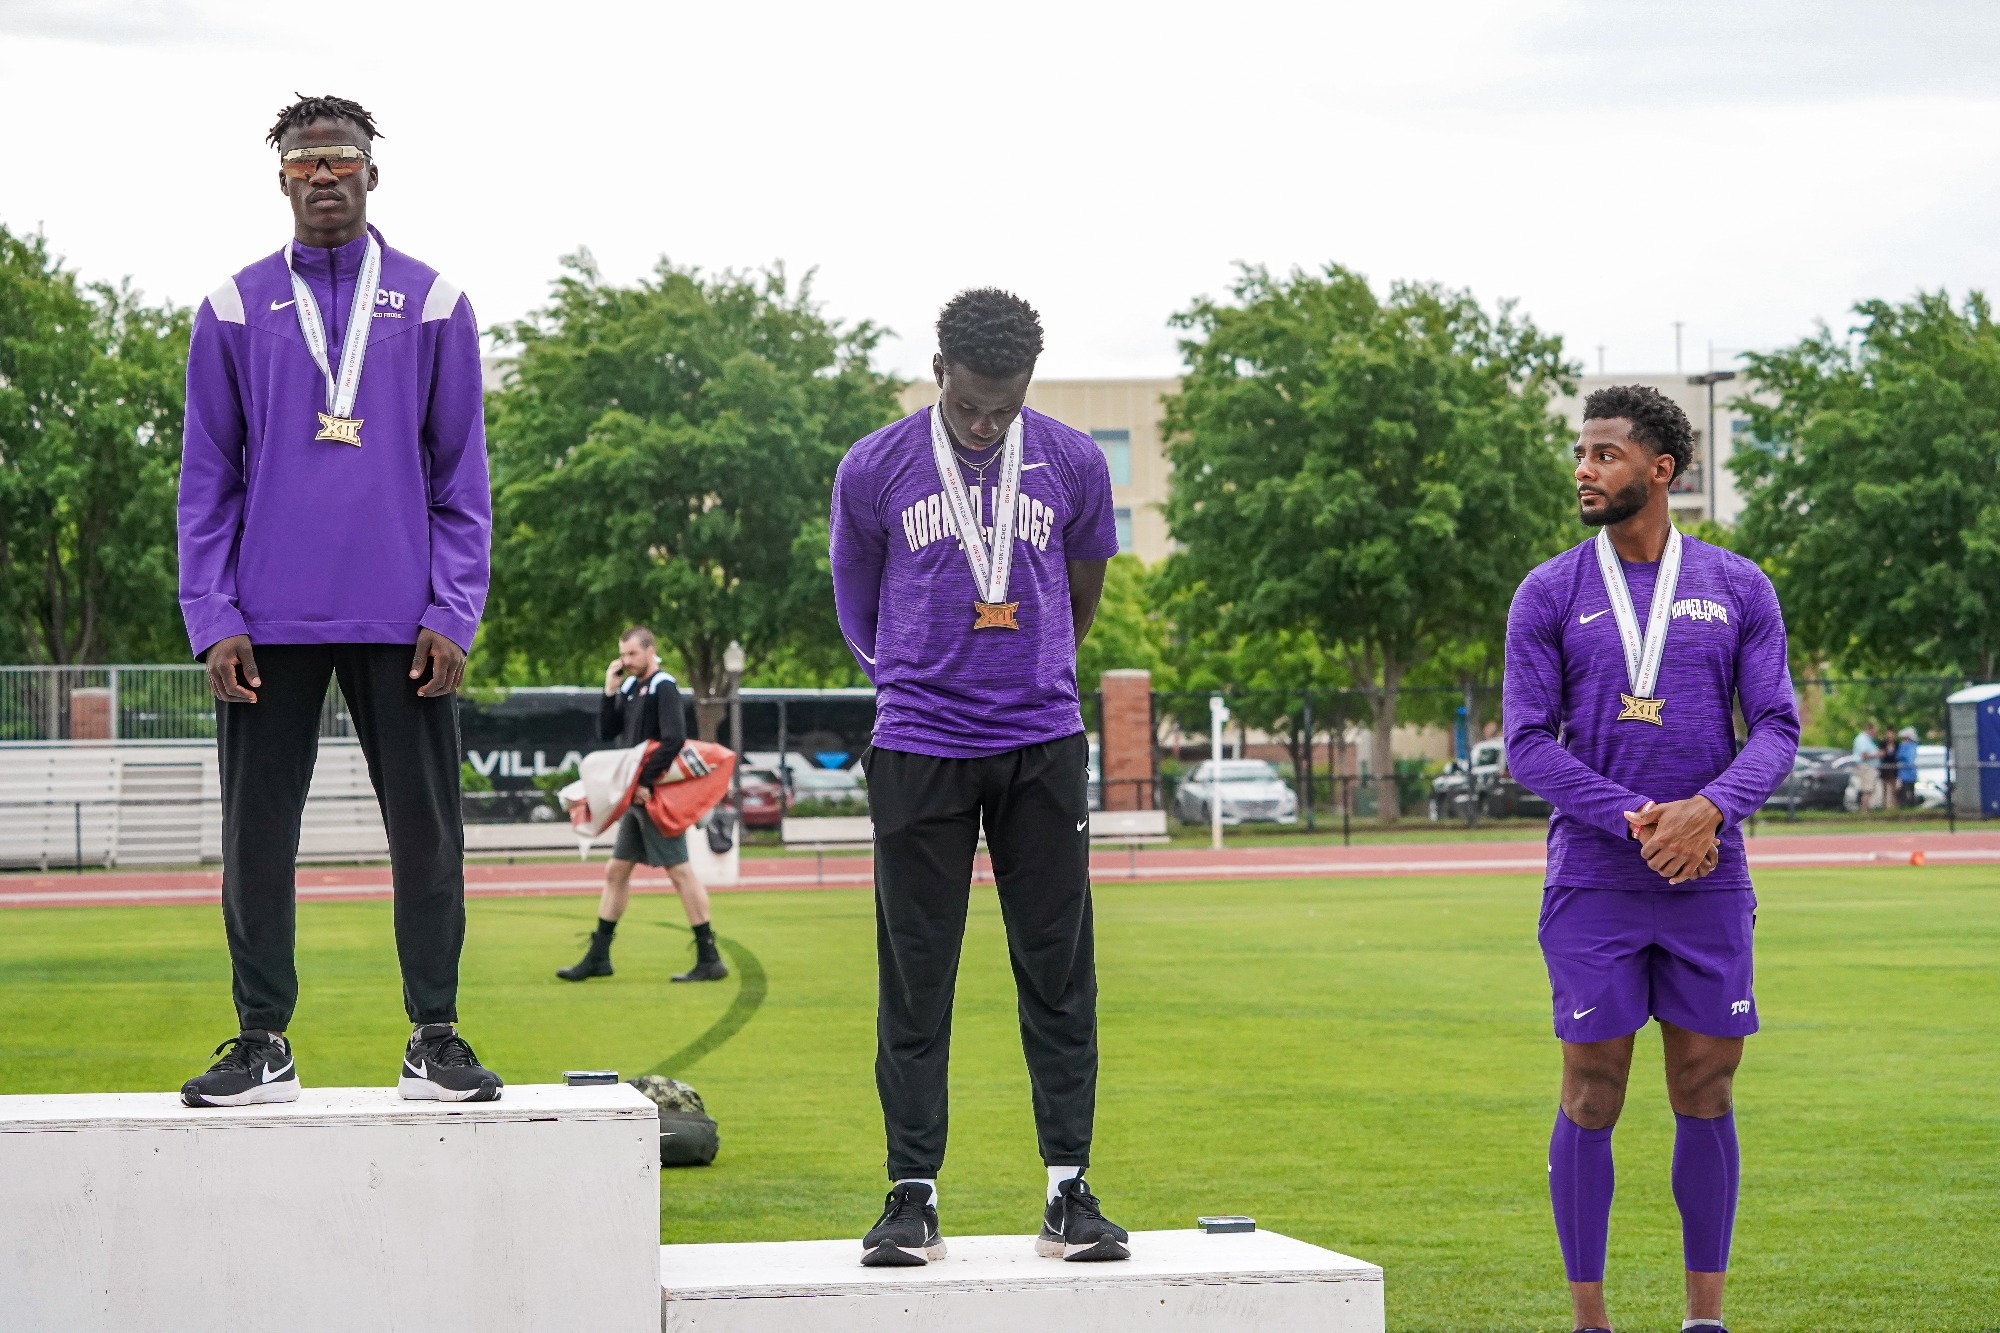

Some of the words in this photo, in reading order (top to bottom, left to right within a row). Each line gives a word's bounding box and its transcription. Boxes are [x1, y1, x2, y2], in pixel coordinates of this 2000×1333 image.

[376, 289, 406, 310] CU
[902, 485, 983, 553] HORND
[1731, 1000, 1750, 1016] TCU
